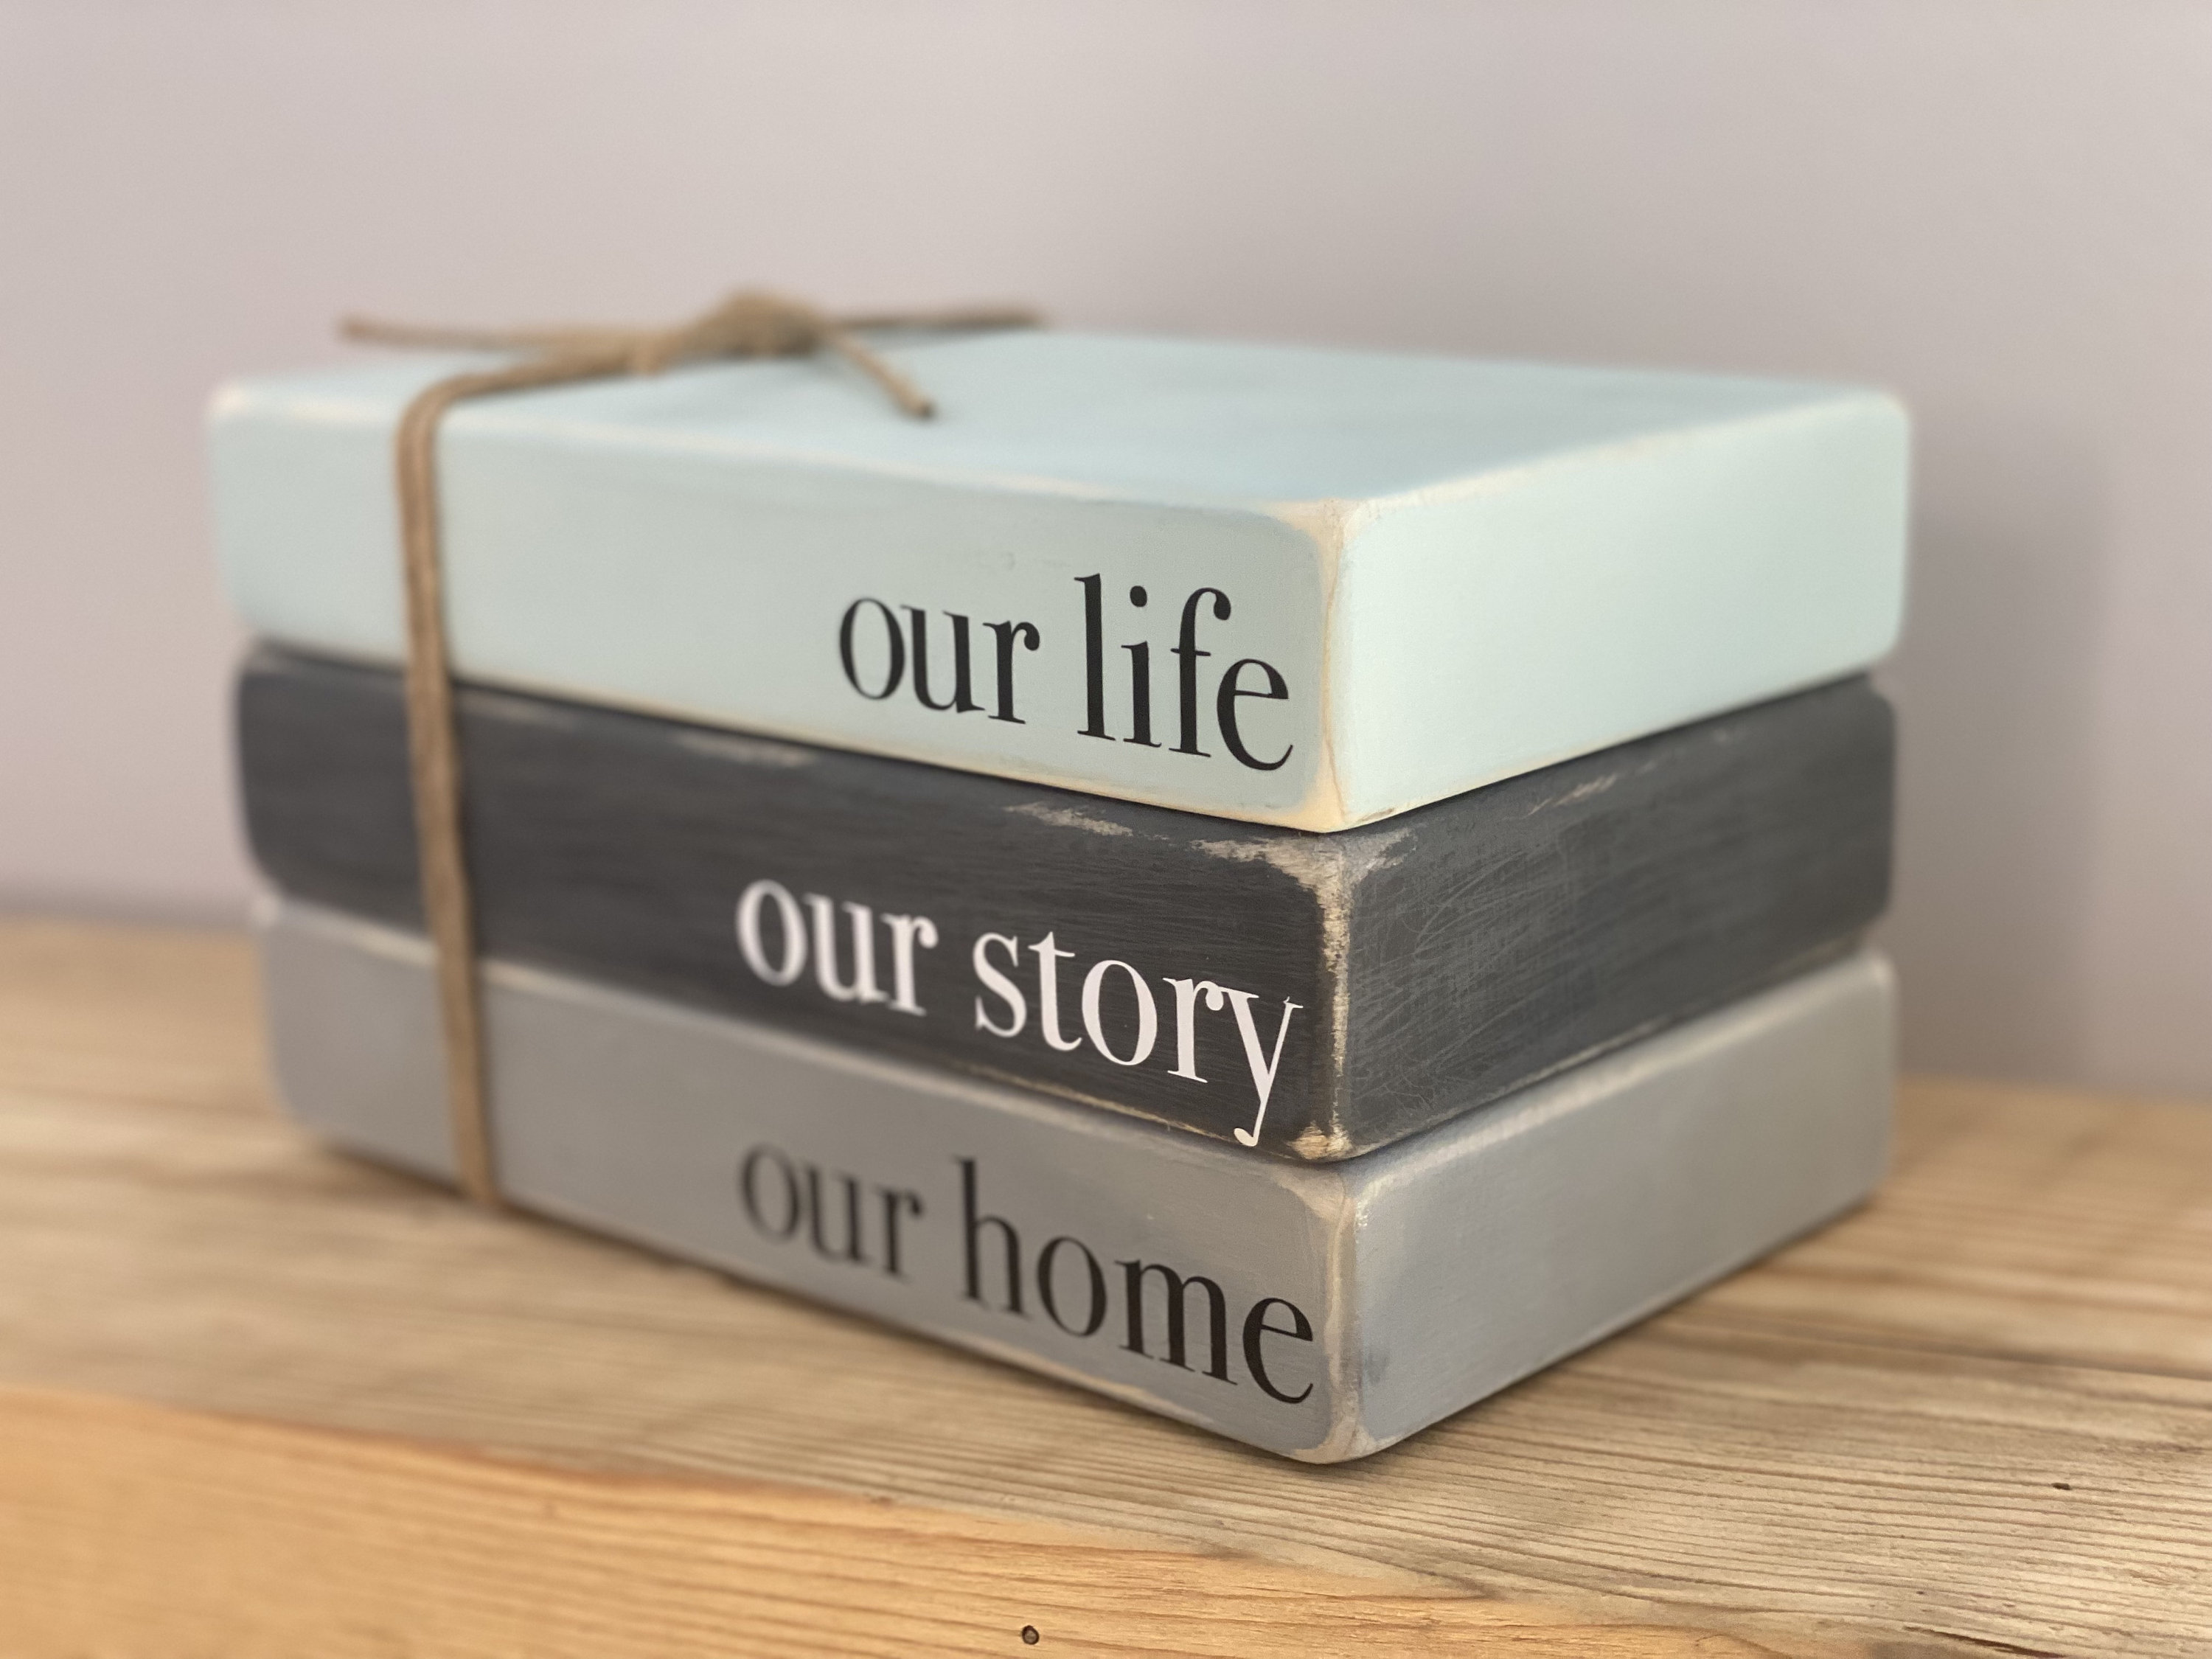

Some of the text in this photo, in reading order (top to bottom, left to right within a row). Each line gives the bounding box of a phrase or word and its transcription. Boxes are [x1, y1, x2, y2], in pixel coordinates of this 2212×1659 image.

[838, 573, 1294, 772] our life
[736, 880, 1304, 1147] our story
[740, 1143, 1315, 1405] our home
